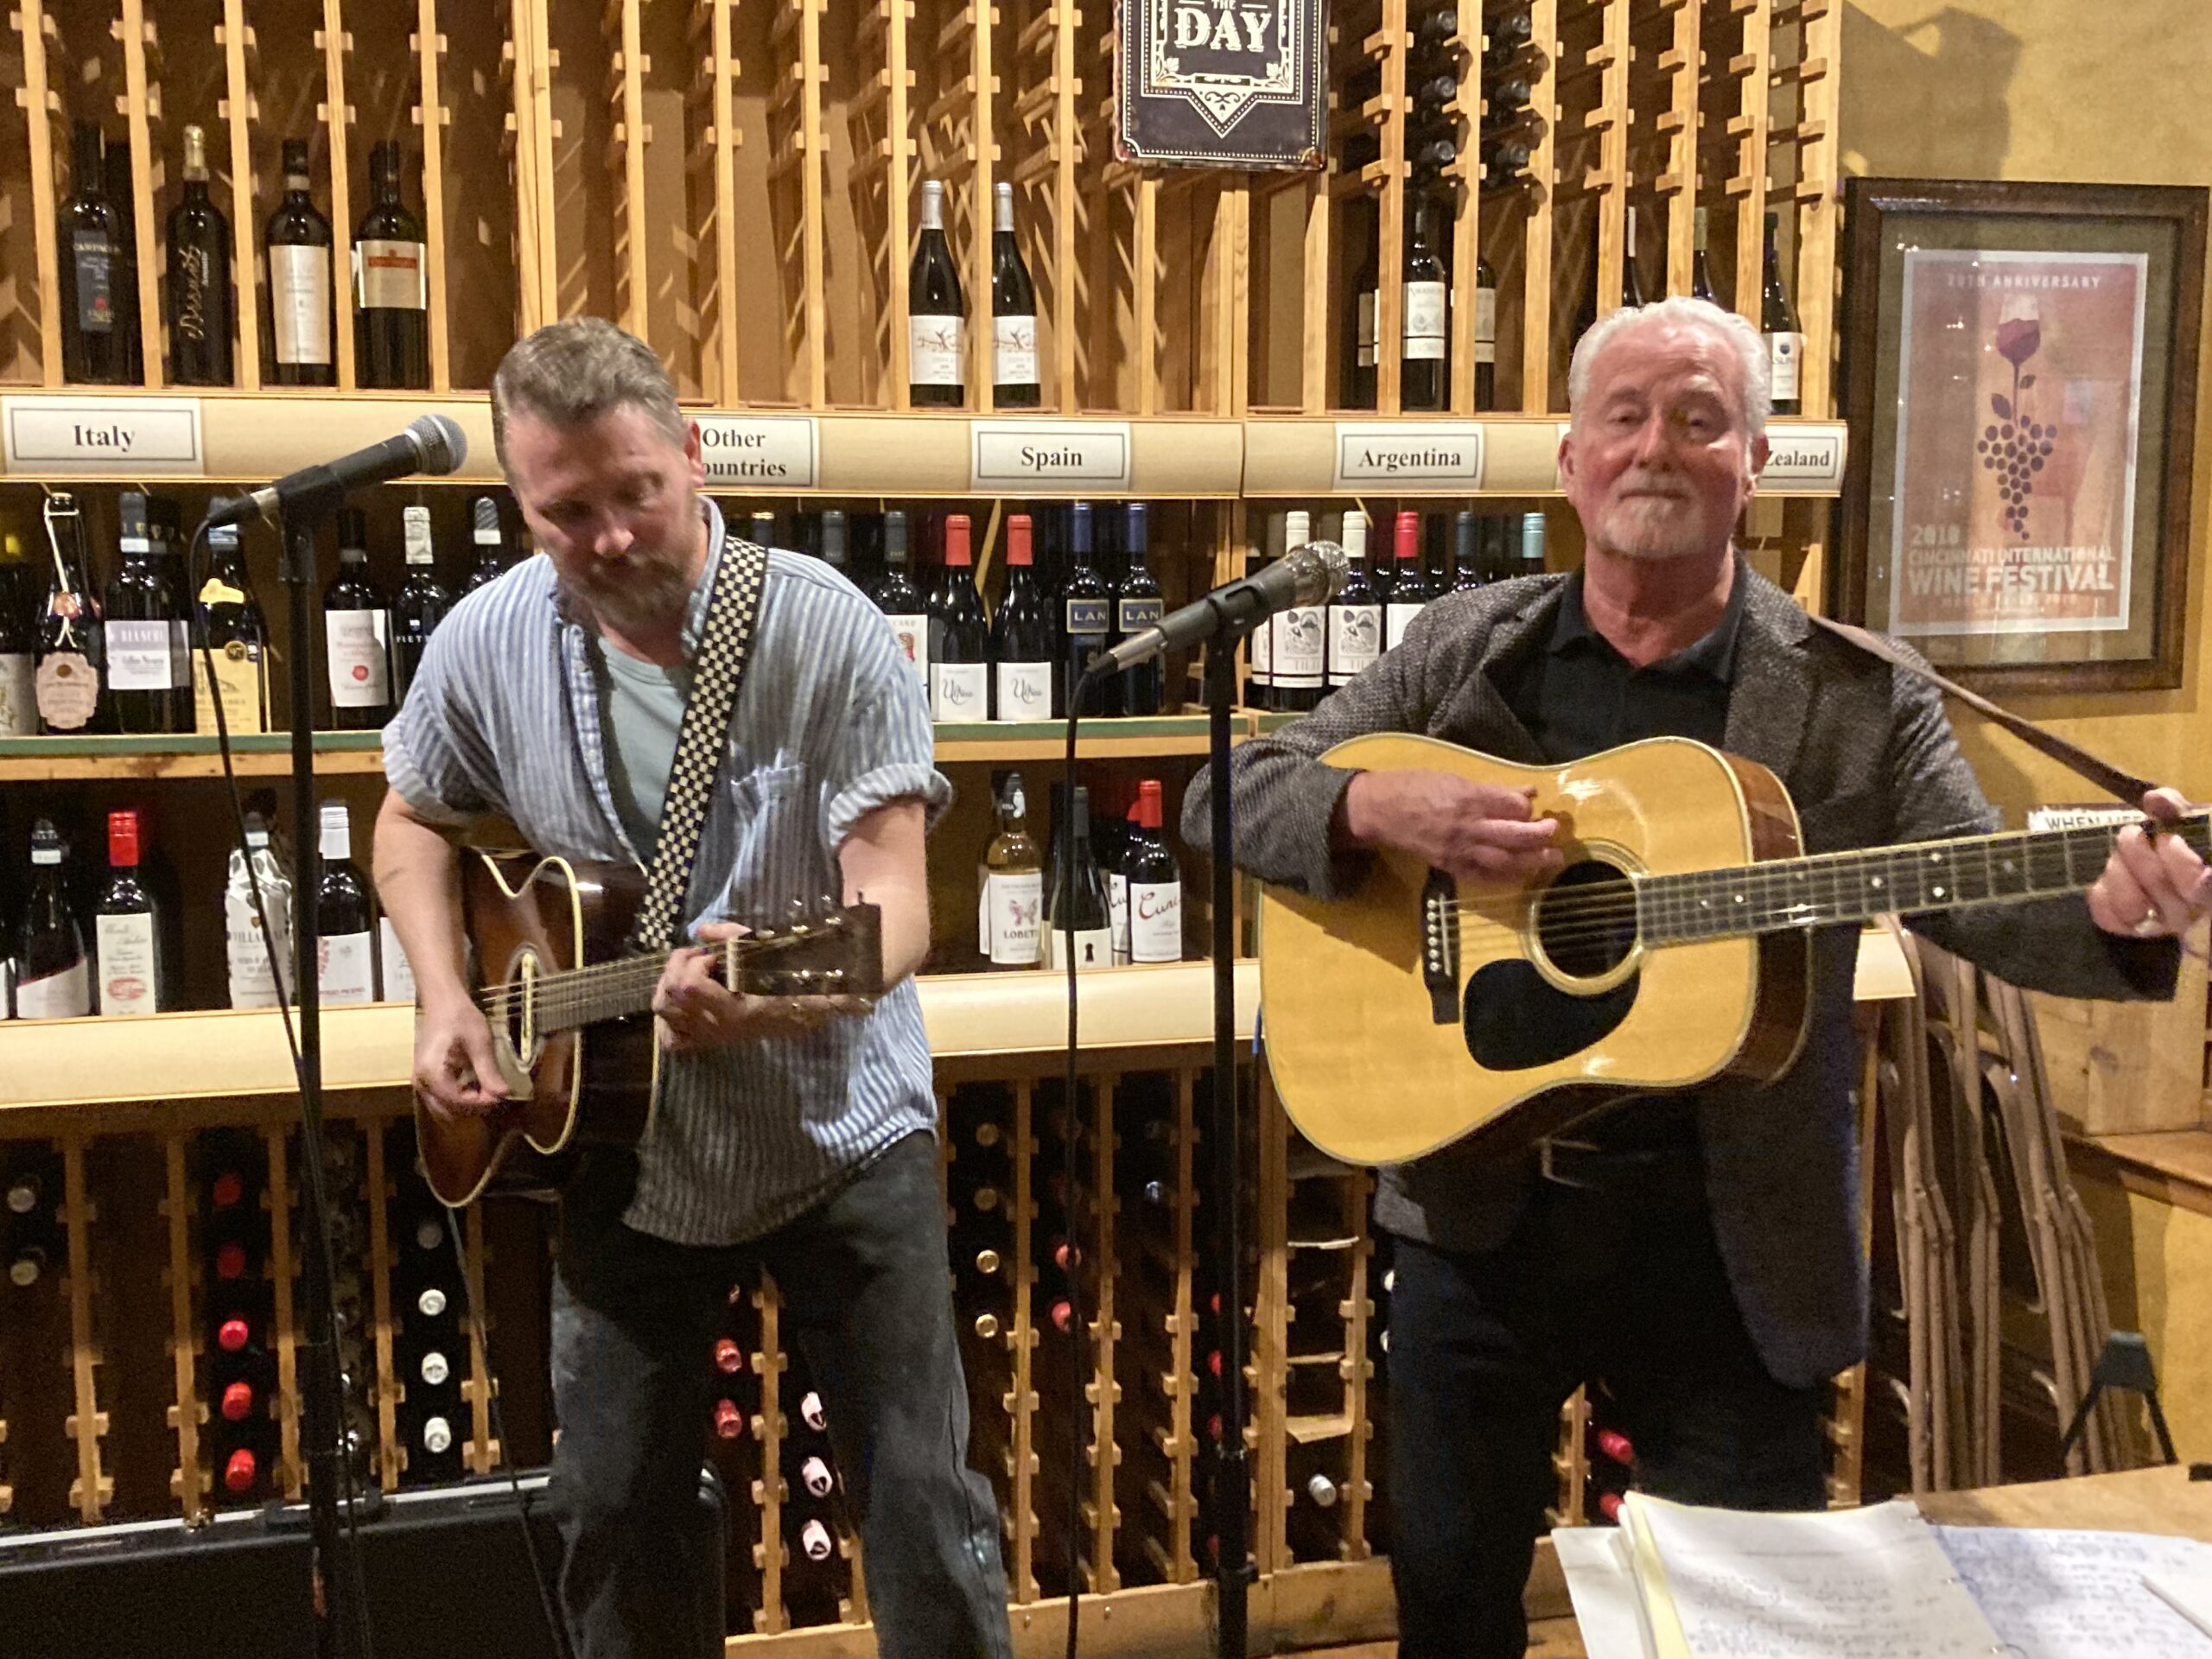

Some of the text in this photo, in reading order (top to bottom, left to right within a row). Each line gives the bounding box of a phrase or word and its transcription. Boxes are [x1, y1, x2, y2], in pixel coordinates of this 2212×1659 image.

[1212, 0, 1236, 10] THE
[1173, 7, 1272, 53] DAY
[1993, 274, 2101, 289] ANNIVERSARY
[73, 424, 135, 452] Italy
[702, 429, 766, 448] Other
[702, 458, 787, 477] ountries
[1020, 446, 1083, 471] Spain
[1357, 447, 1461, 472] Argentina
[1908, 545, 2115, 565] CINCINNATI INTERNATIONAL
[1908, 562, 2115, 595] WINE FESTIVAL
[1073, 610, 1107, 621] LAN
[1125, 610, 1160, 620] LAN
